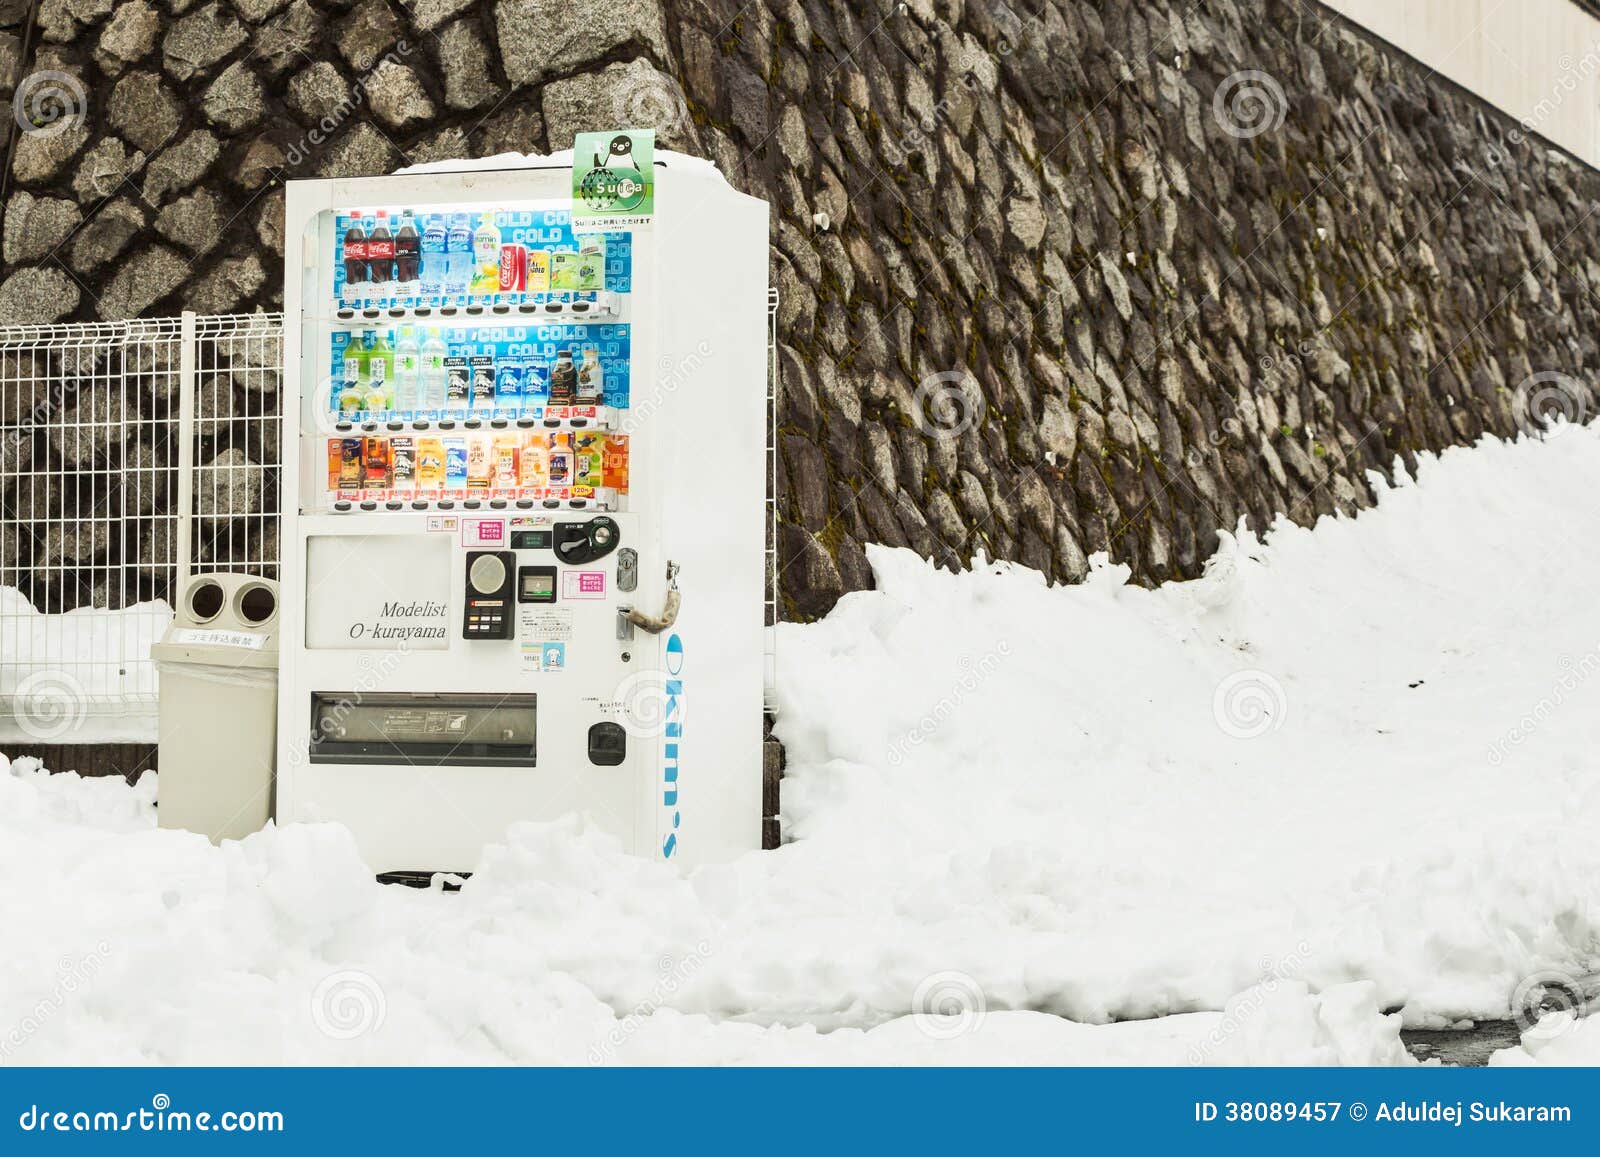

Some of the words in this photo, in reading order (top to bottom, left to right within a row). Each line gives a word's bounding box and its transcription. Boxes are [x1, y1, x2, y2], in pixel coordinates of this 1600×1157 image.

[597, 182, 642, 194] Suica
[512, 228, 562, 243] COLD
[478, 327, 527, 342] COLD
[538, 325, 588, 340] COLD
[508, 343, 556, 358] COLD
[380, 601, 447, 617] Modelist
[349, 623, 446, 641] O-kurayama
